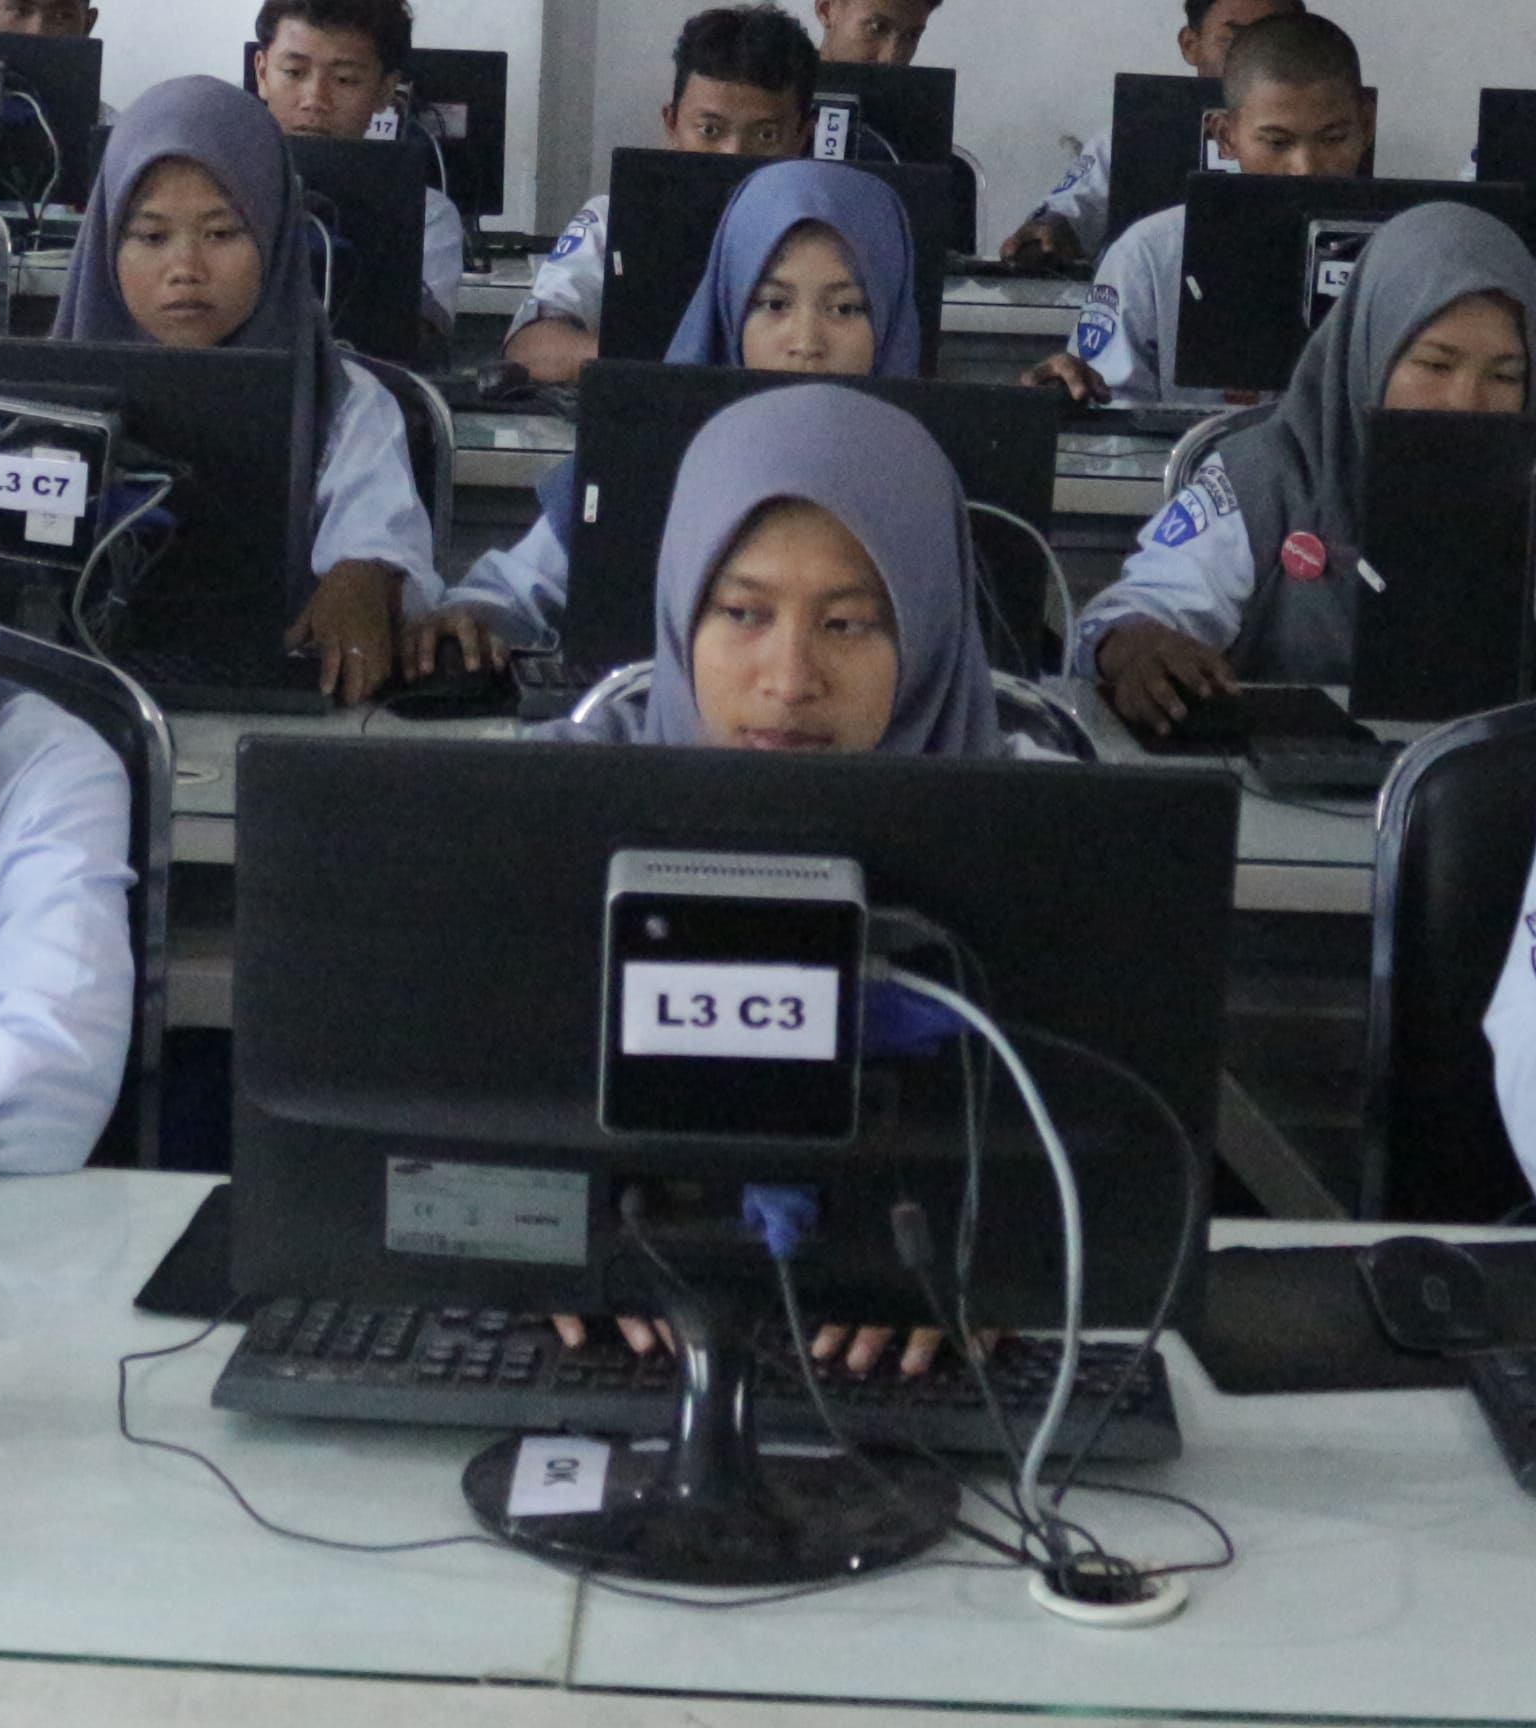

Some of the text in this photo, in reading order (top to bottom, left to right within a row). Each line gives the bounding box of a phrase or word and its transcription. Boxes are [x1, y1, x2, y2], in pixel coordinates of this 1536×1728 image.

[369, 120, 393, 134] 17
[32, 474, 71, 498] C7
[657, 992, 806, 1031] L3 C3
[544, 1458, 580, 1485] OK
